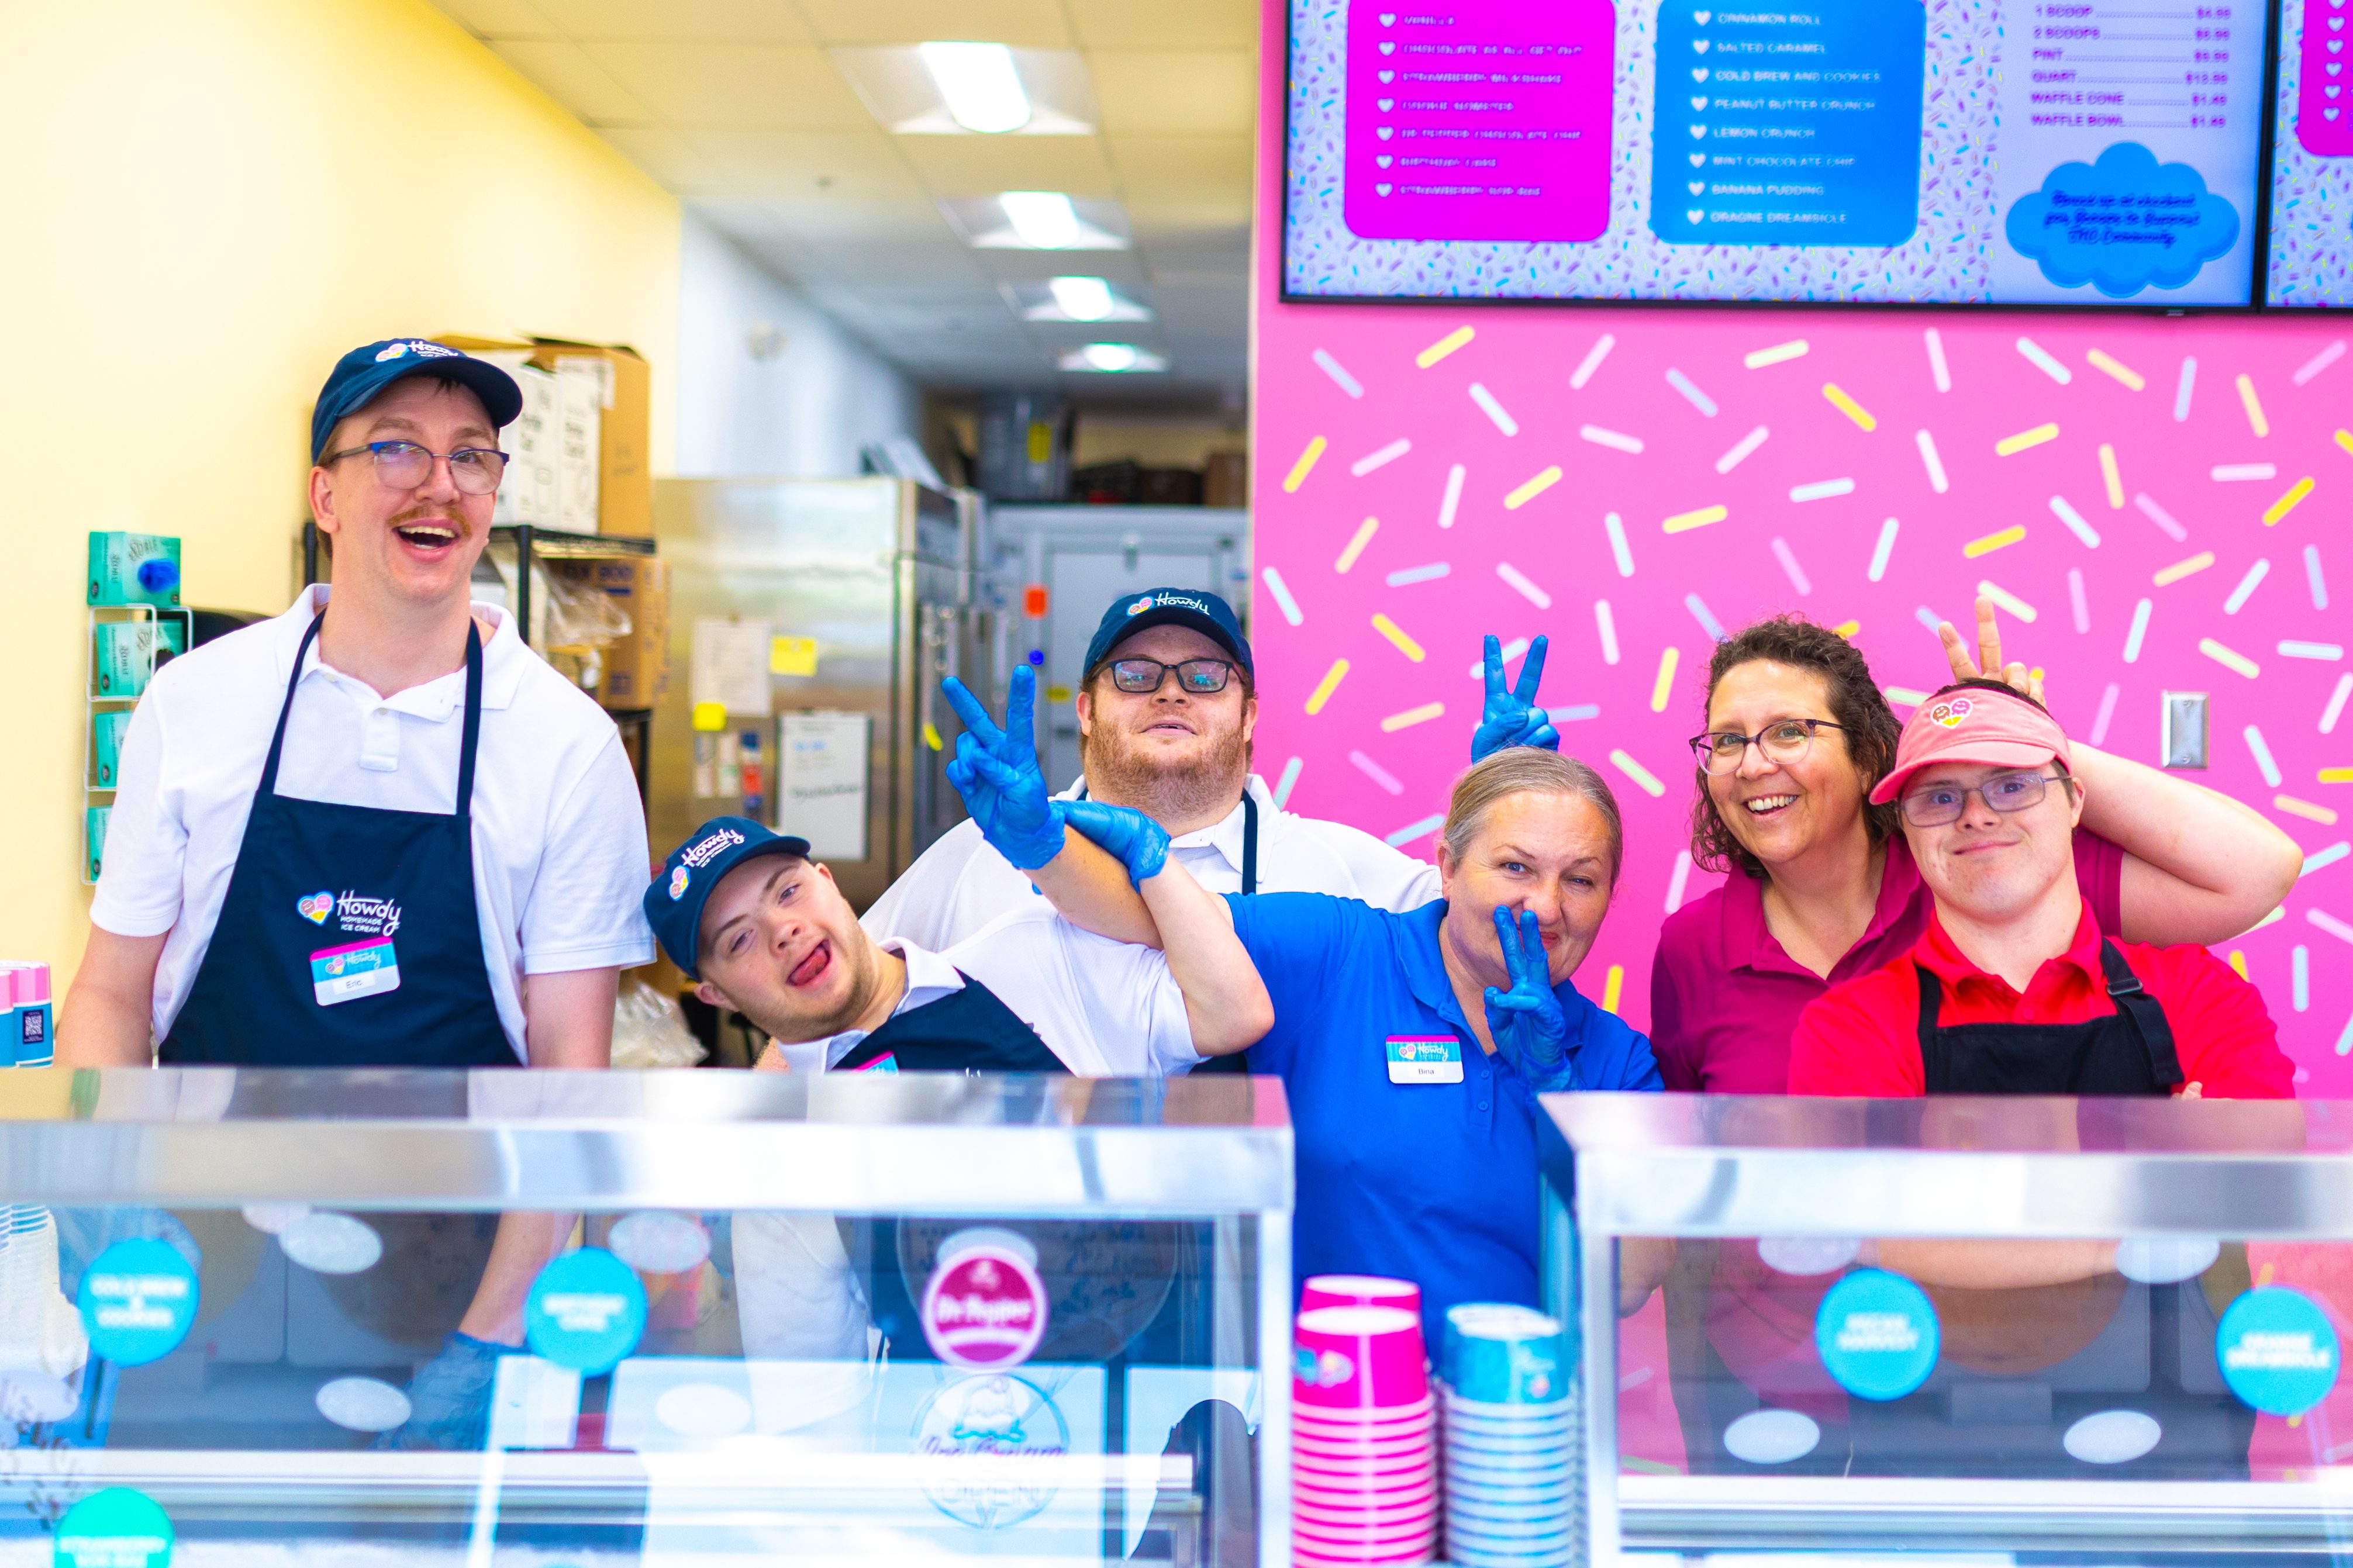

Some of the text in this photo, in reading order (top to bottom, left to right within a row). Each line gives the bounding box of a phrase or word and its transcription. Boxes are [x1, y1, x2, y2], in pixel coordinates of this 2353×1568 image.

[1717, 13, 1821, 25] CINNAMON ROLL
[1717, 42, 1826, 54] SALTED CARAMEL
[2033, 47, 2063, 60] PINT
[1715, 70, 1881, 83] COLD BREW AND COOKIES
[1714, 98, 1875, 111] PEANUT BUTTER CRUNCH
[2031, 91, 2124, 105] WAFFLE CONE
[2031, 112, 2126, 127] WAFFLE BOWL
[1713, 127, 1815, 139] LEMON CRUNCH
[1713, 156, 1742, 167] MINT
[1746, 156, 1821, 167] CHOCOLATE
[1711, 184, 1825, 196] BANANA PUDDING
[681, 828, 745, 867] Howdy
[336, 889, 401, 937] Howdy
[340, 916, 383, 925] HOMEMADE
[354, 924, 381, 934] CREAM
[346, 951, 381, 969] Howdy
[346, 979, 363, 989] Eric
[1417, 1042, 1448, 1062] Howdy
